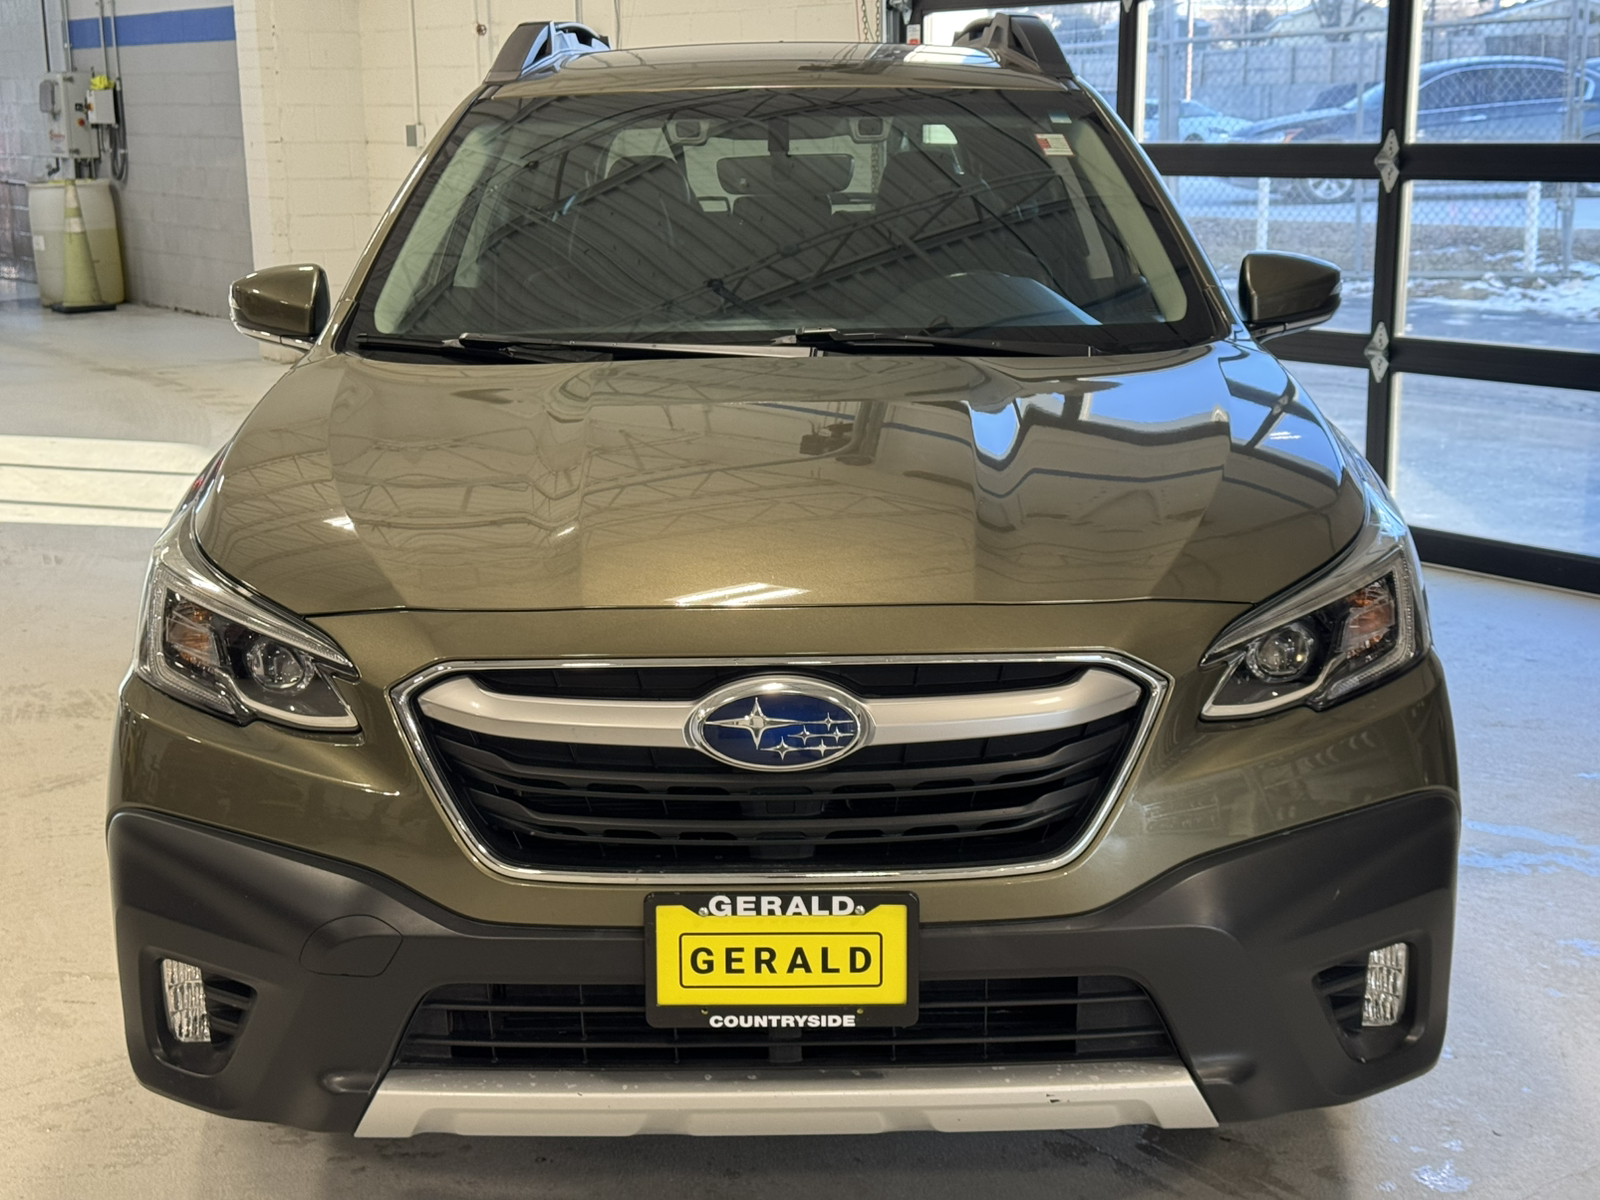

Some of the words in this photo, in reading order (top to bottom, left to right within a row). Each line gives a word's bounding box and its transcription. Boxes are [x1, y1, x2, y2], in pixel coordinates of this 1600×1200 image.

[708, 895, 855, 916] GERALD
[690, 946, 872, 975] GERALD
[708, 1014, 856, 1028] COUNTRYSIDE
